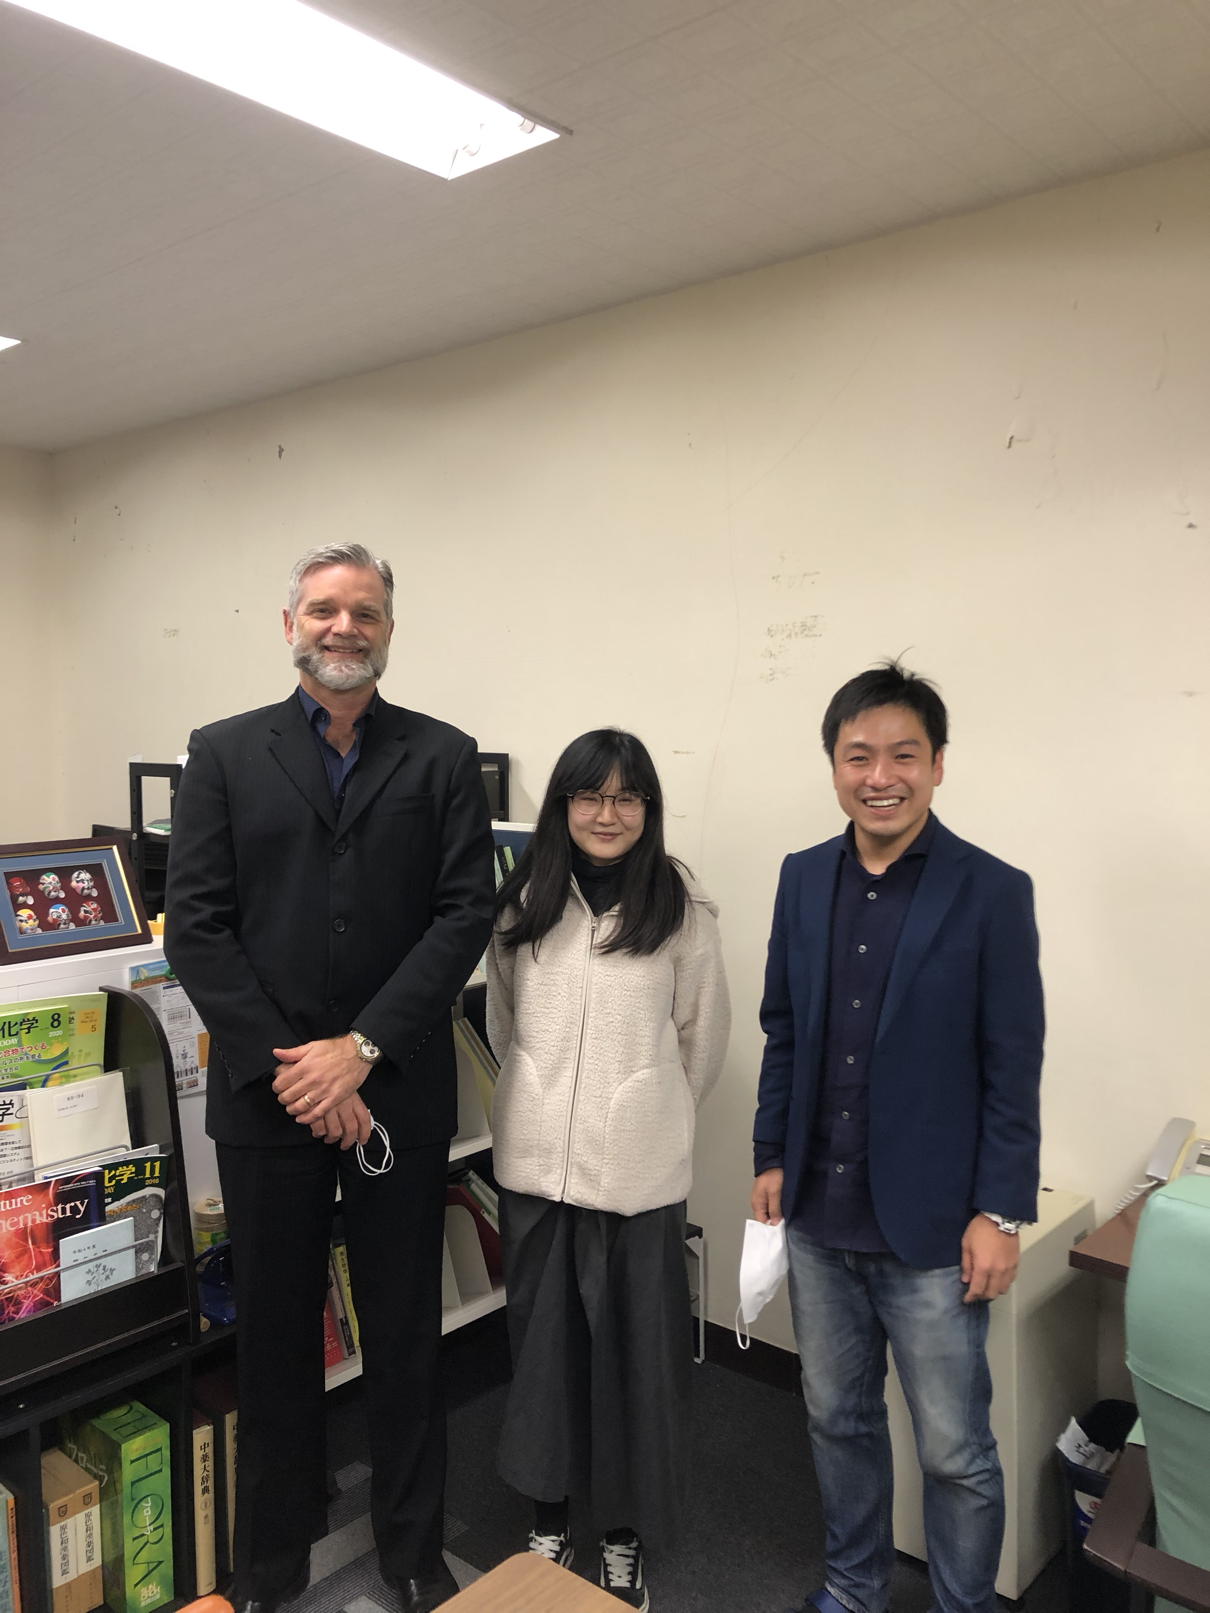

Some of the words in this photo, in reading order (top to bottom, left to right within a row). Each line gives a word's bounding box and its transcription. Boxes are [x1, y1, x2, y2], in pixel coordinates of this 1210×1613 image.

[0, 1016, 39, 1039] 化学
[50, 1012, 62, 1029] 8
[144, 1160, 161, 1178] 11
[129, 1446, 164, 1590] FLORA
